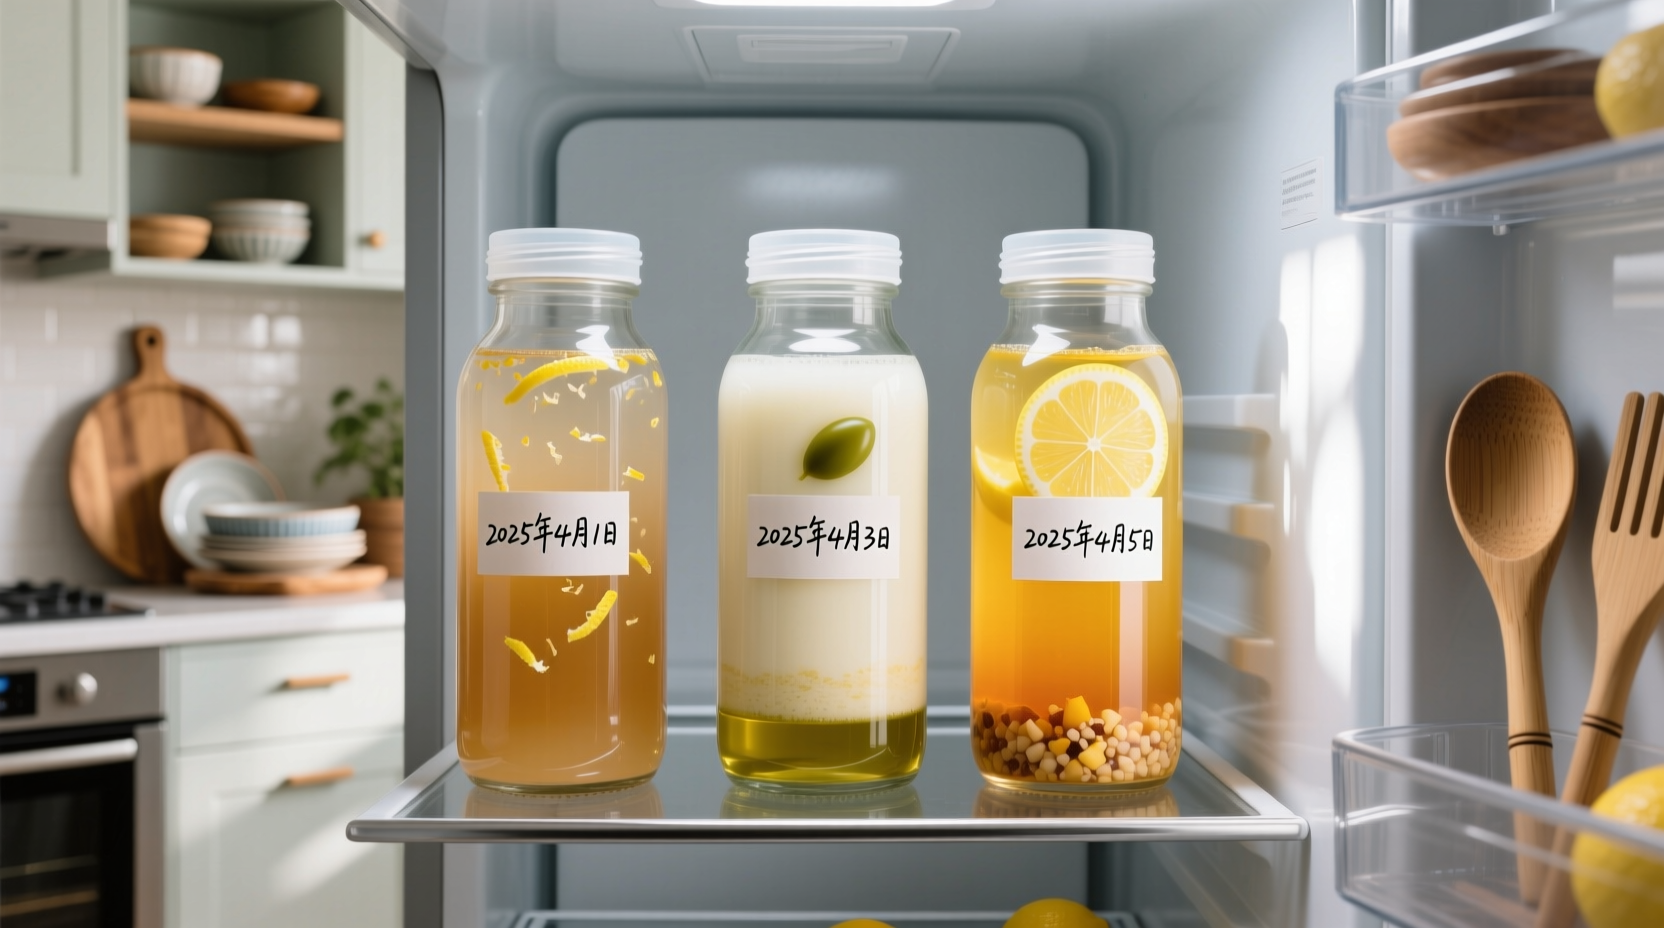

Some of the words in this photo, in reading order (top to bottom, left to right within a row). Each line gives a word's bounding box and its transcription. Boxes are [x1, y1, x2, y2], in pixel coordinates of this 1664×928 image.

[485, 512, 617, 554] 2025年4月1日
[756, 515, 890, 557] 2025年4月3日
[1023, 519, 1154, 559] 2025年4月5日
